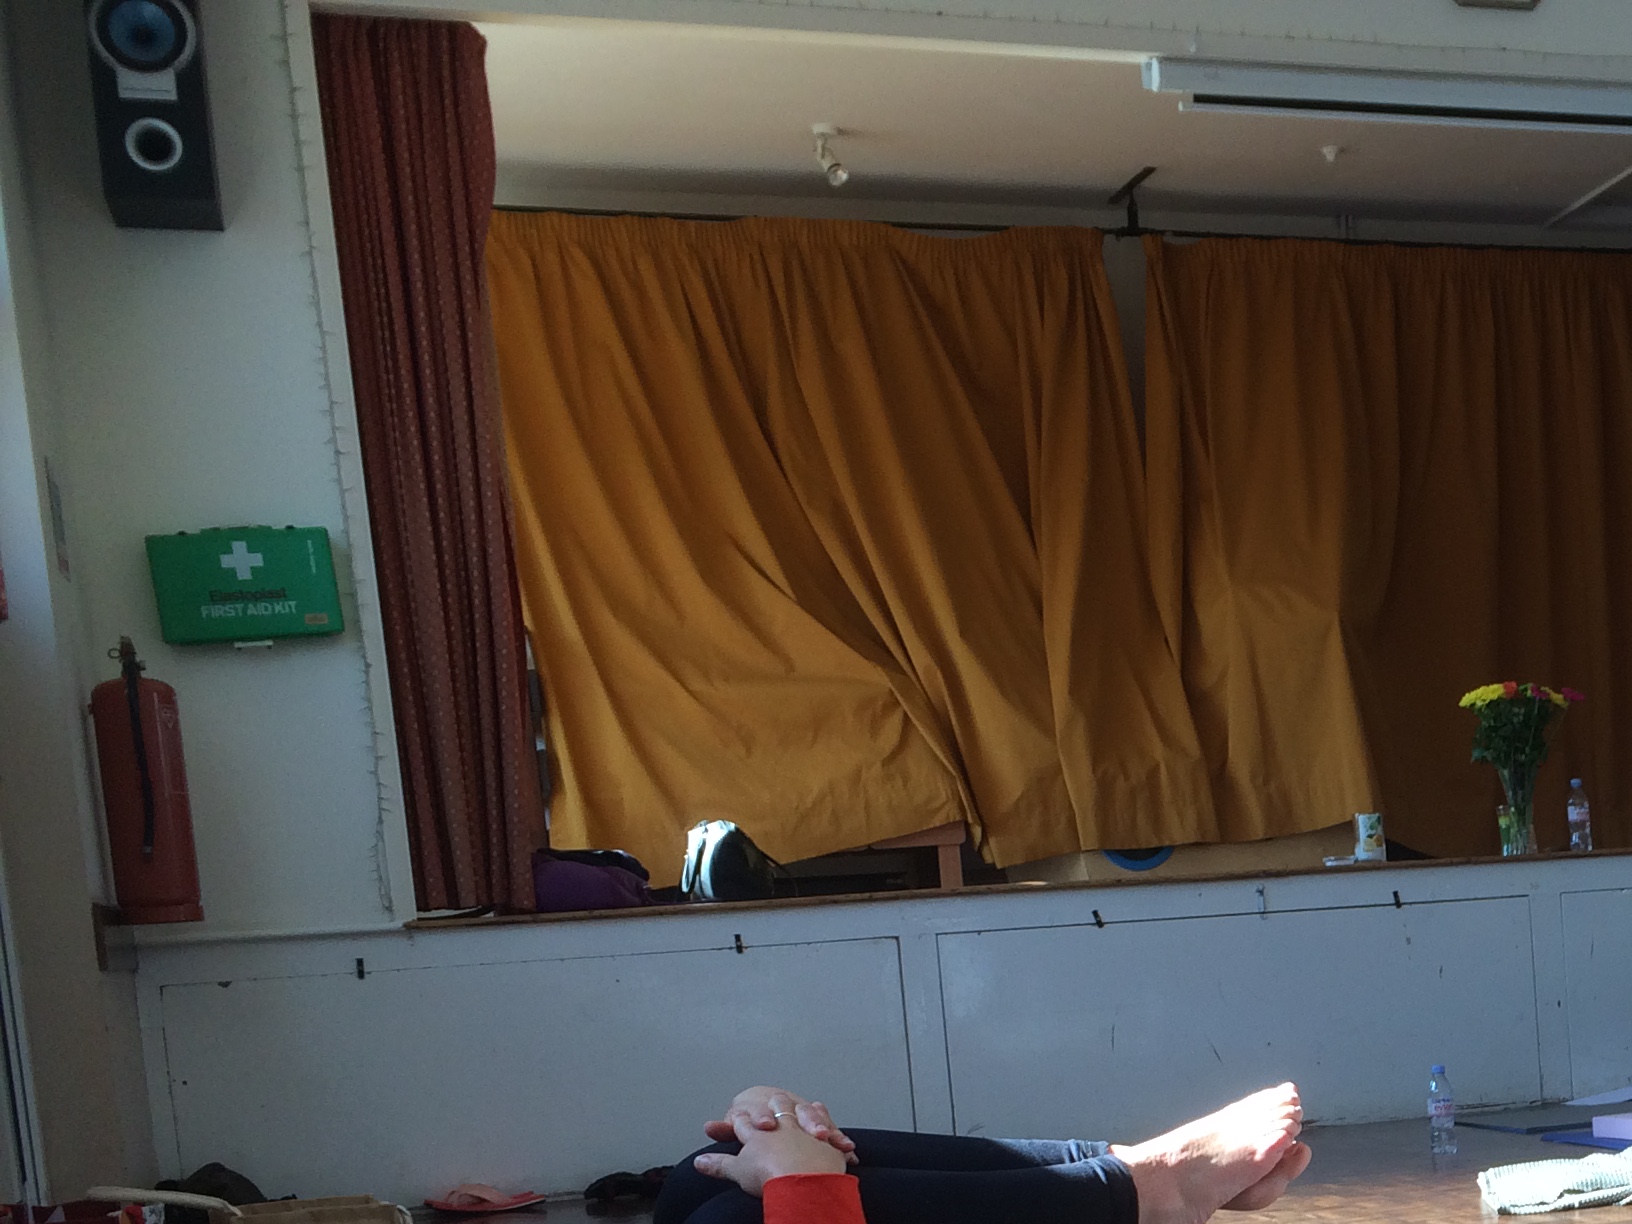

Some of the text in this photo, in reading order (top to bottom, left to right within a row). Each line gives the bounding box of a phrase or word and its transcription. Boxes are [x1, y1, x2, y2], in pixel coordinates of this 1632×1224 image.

[201, 601, 296, 618] FIRST AID KIT
